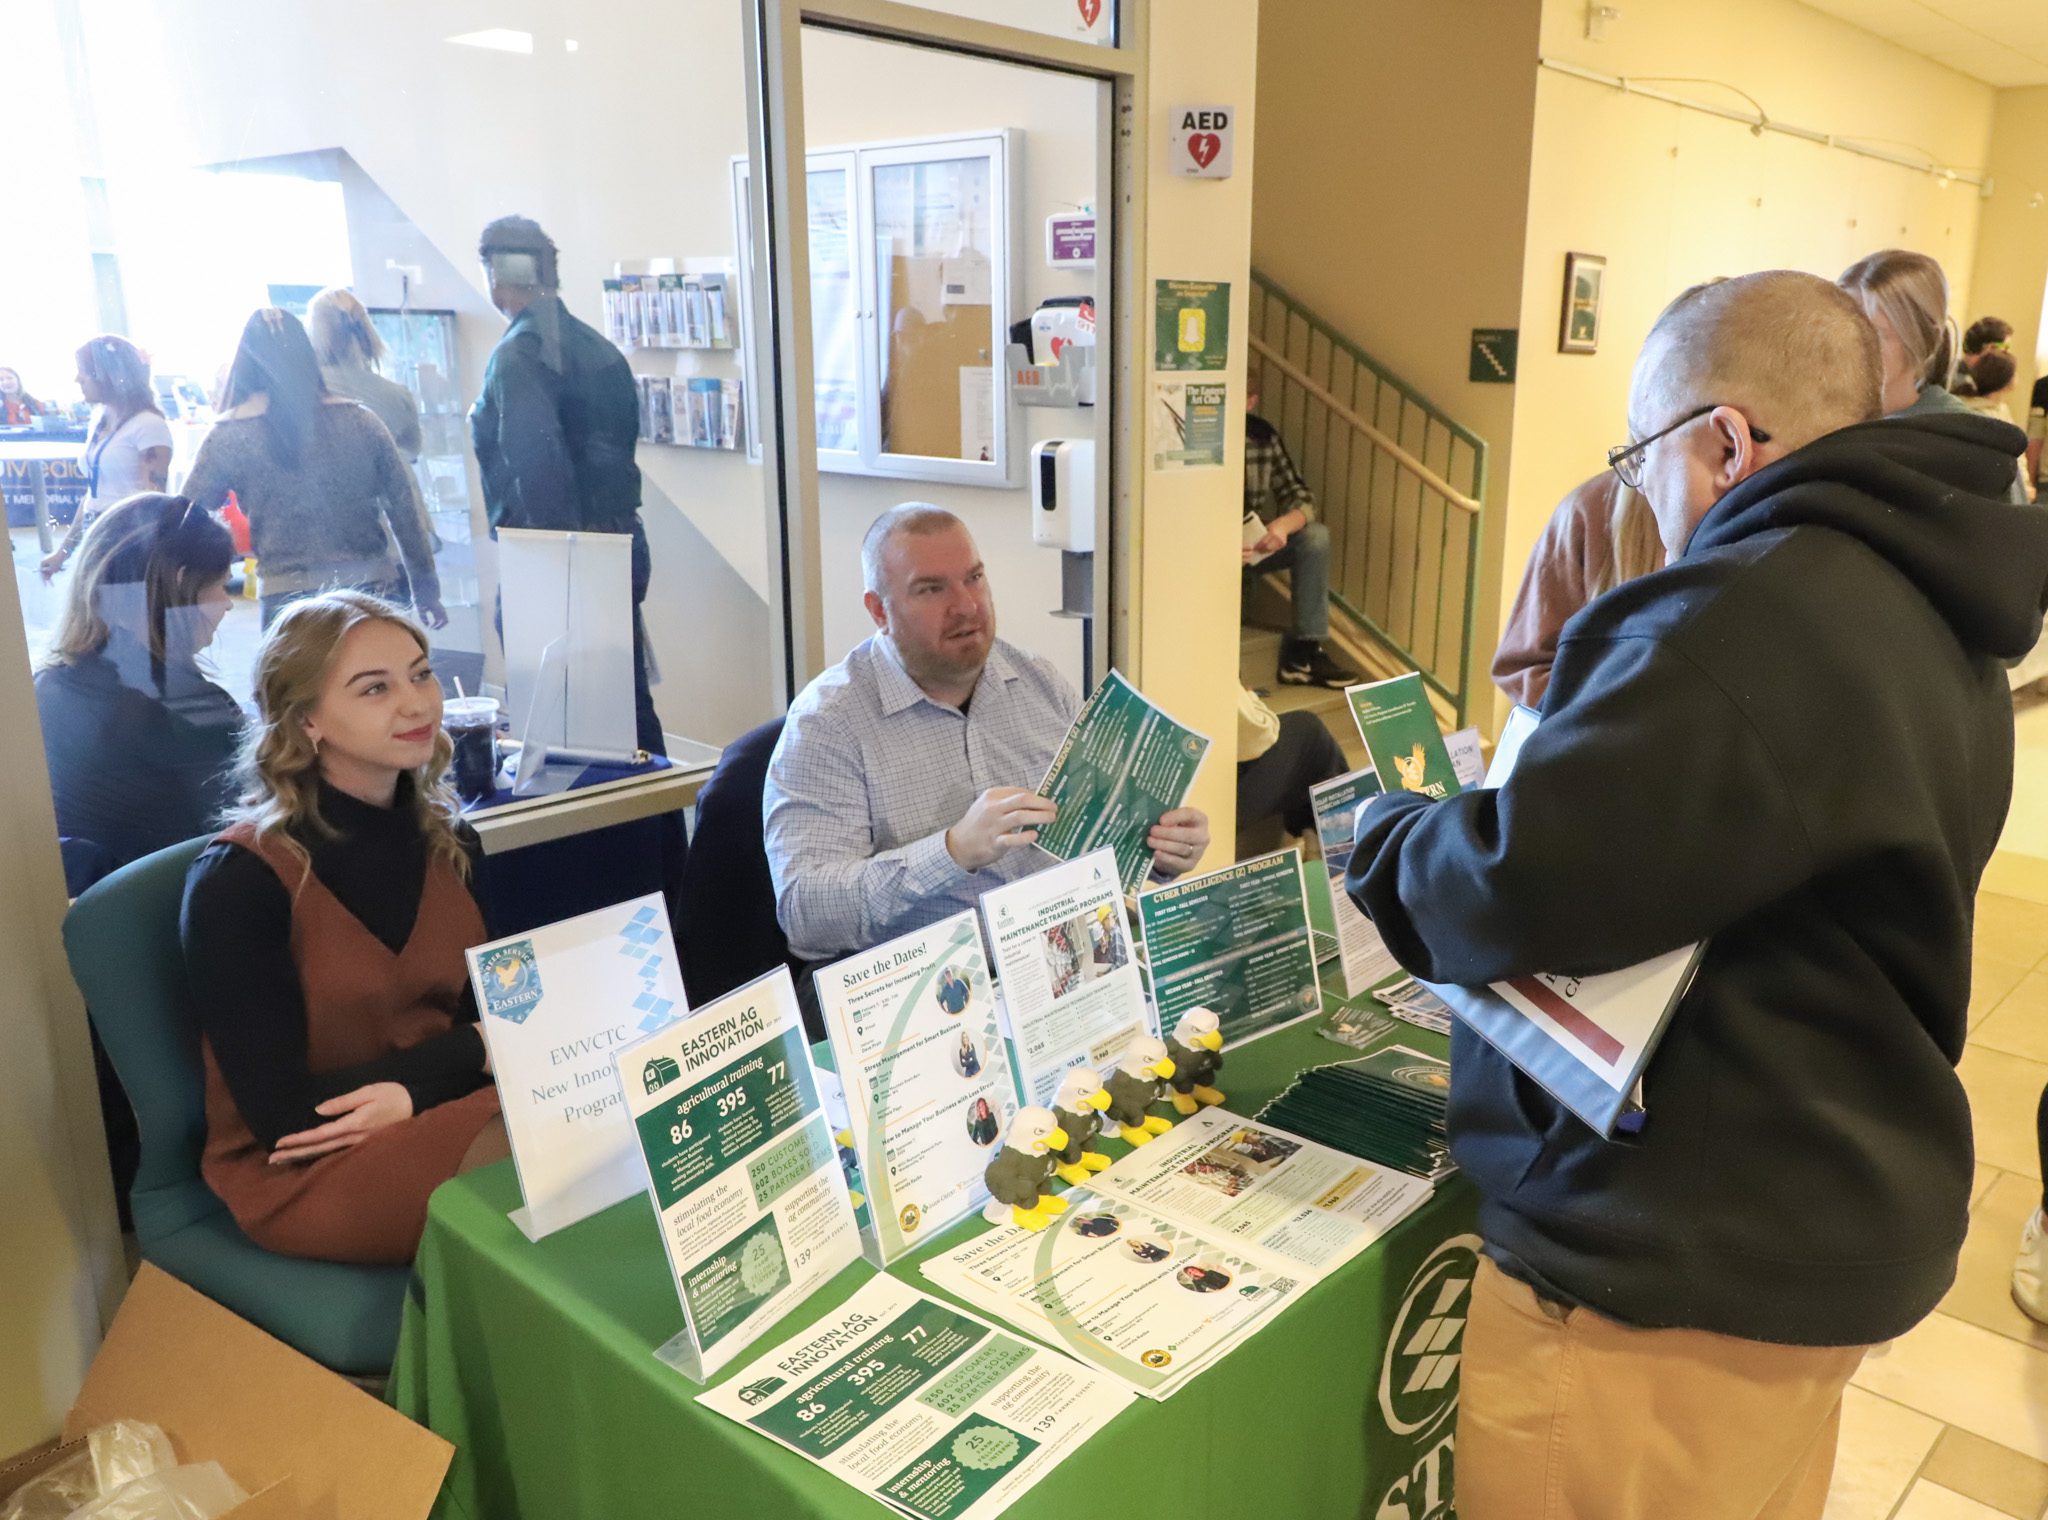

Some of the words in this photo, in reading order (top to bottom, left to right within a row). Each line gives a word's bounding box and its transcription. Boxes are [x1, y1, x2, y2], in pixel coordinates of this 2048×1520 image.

[1182, 111, 1228, 130] AED
[1017, 370, 1040, 385] AED
[1426, 780, 1446, 799] ERN
[1133, 857, 1150, 889] EASTERN
[1153, 887, 1180, 903] CYBER
[1180, 870, 1233, 894] INTELLIGENCE
[1247, 855, 1283, 873] PROGRAM
[999, 917, 1047, 942] MAINTENANCE
[1048, 904, 1078, 920] TRAINING
[1079, 889, 1113, 908] PROGRAMS
[1037, 897, 1074, 916] INDUSTRIAL
[842, 969, 869, 987] Save
[872, 960, 890, 975] the
[893, 941, 926, 966] Dates!
[847, 994, 863, 1004] Three
[863, 985, 885, 998] Secrets
[893, 969, 920, 984] Increasing
[920, 962, 936, 972] Profit
[492, 989, 539, 1012] EASTERN
[550, 1024, 627, 1066] EWVCTC
[681, 1017, 736, 1056] EASTERN
[740, 1006, 757, 1025] AG
[685, 1019, 763, 1071] INNOVATION
[863, 1061, 881, 1072] Stress
[881, 1044, 915, 1064] Management
[915, 1039, 923, 1047] for
[923, 1032, 939, 1043] Smart
[939, 1022, 961, 1035] Business
[531, 1080, 570, 1105] New
[670, 1119, 692, 1144] 86
[716, 1086, 746, 1116] 395
[766, 1060, 784, 1084] 77
[677, 1075, 729, 1114] agricultural
[729, 1056, 763, 1082] training
[881, 1136, 894, 1146] How
[900, 1120, 921, 1135] Manage
[921, 1113, 934, 1123] Your
[934, 1101, 957, 1116] Business
[956, 1094, 968, 1104] with
[979, 1080, 994, 1092] Stress
[751, 1162, 765, 1178] 250
[755, 1174, 769, 1190] 602
[770, 1155, 797, 1179] BOXES
[1129, 1164, 1178, 1195] MAINTENANCE
[1174, 1144, 1209, 1165] TRAINING
[1202, 1122, 1242, 1146] PROGRAMS
[1159, 1144, 1197, 1167] INDUSTRIAL
[758, 1189, 768, 1202] 25
[769, 1163, 805, 1193] PARTNER
[784, 1183, 818, 1212] supporting
[817, 1175, 828, 1187] the
[673, 1193, 715, 1225] stimulating
[715, 1184, 727, 1197] the
[676, 1218, 694, 1237] local
[695, 1206, 712, 1226] food
[713, 1187, 743, 1212] economy
[787, 1211, 797, 1222] ag
[796, 1187, 830, 1215] community
[751, 1243, 765, 1261] 25
[793, 1247, 811, 1268] 139
[952, 1246, 984, 1263] Save
[983, 1234, 1005, 1247] the
[968, 1259, 987, 1270] Three
[985, 1248, 1008, 1261] Secrets
[1018, 1285, 1039, 1297] Stress
[1036, 1264, 1073, 1287] Management
[1080, 1249, 1098, 1260] Smart
[1096, 1236, 1121, 1251] Business
[688, 1256, 726, 1288] internship
[690, 1285, 700, 1300] &
[699, 1260, 737, 1293] mentoring
[1076, 1319, 1091, 1329] How
[1097, 1300, 1120, 1315] Manage
[1119, 1291, 1134, 1301] Your
[1132, 1278, 1157, 1292] Business
[1156, 1270, 1169, 1279] with
[1167, 1262, 1181, 1271] Less
[1178, 1252, 1196, 1264] Stress
[777, 1328, 841, 1370] EASTERN
[841, 1313, 863, 1329] AG
[788, 1315, 877, 1376] INNOVATION
[796, 1361, 855, 1403] agricultural
[852, 1334, 894, 1363] training
[796, 1402, 825, 1421] 86
[847, 1359, 884, 1385] 395
[900, 1325, 926, 1344] 77
[924, 1388, 943, 1403] 250
[943, 1347, 996, 1388] CUSTOMERS
[936, 1393, 955, 1408] 602
[954, 1370, 985, 1393] BOXES
[984, 1350, 1009, 1370] SOLD
[946, 1403, 960, 1413] 25
[959, 1370, 1001, 1402] PARTNER
[999, 1347, 1030, 1370] FARMS
[990, 1375, 1031, 1406] supporting
[1026, 1364, 1041, 1375] the
[1001, 1399, 1014, 1411] ag
[1008, 1369, 1050, 1402] community
[1032, 1415, 1055, 1432] 139
[1074, 1380, 1095, 1397] EVENTS
[838, 1429, 887, 1464] stimulating
[883, 1418, 898, 1430] the
[847, 1452, 870, 1470] local
[868, 1438, 889, 1455] food
[888, 1413, 923, 1440] economy
[965, 1434, 984, 1449] 25
[886, 1459, 931, 1493] internship
[898, 1490, 909, 1498] &
[907, 1457, 951, 1491] mentoring
